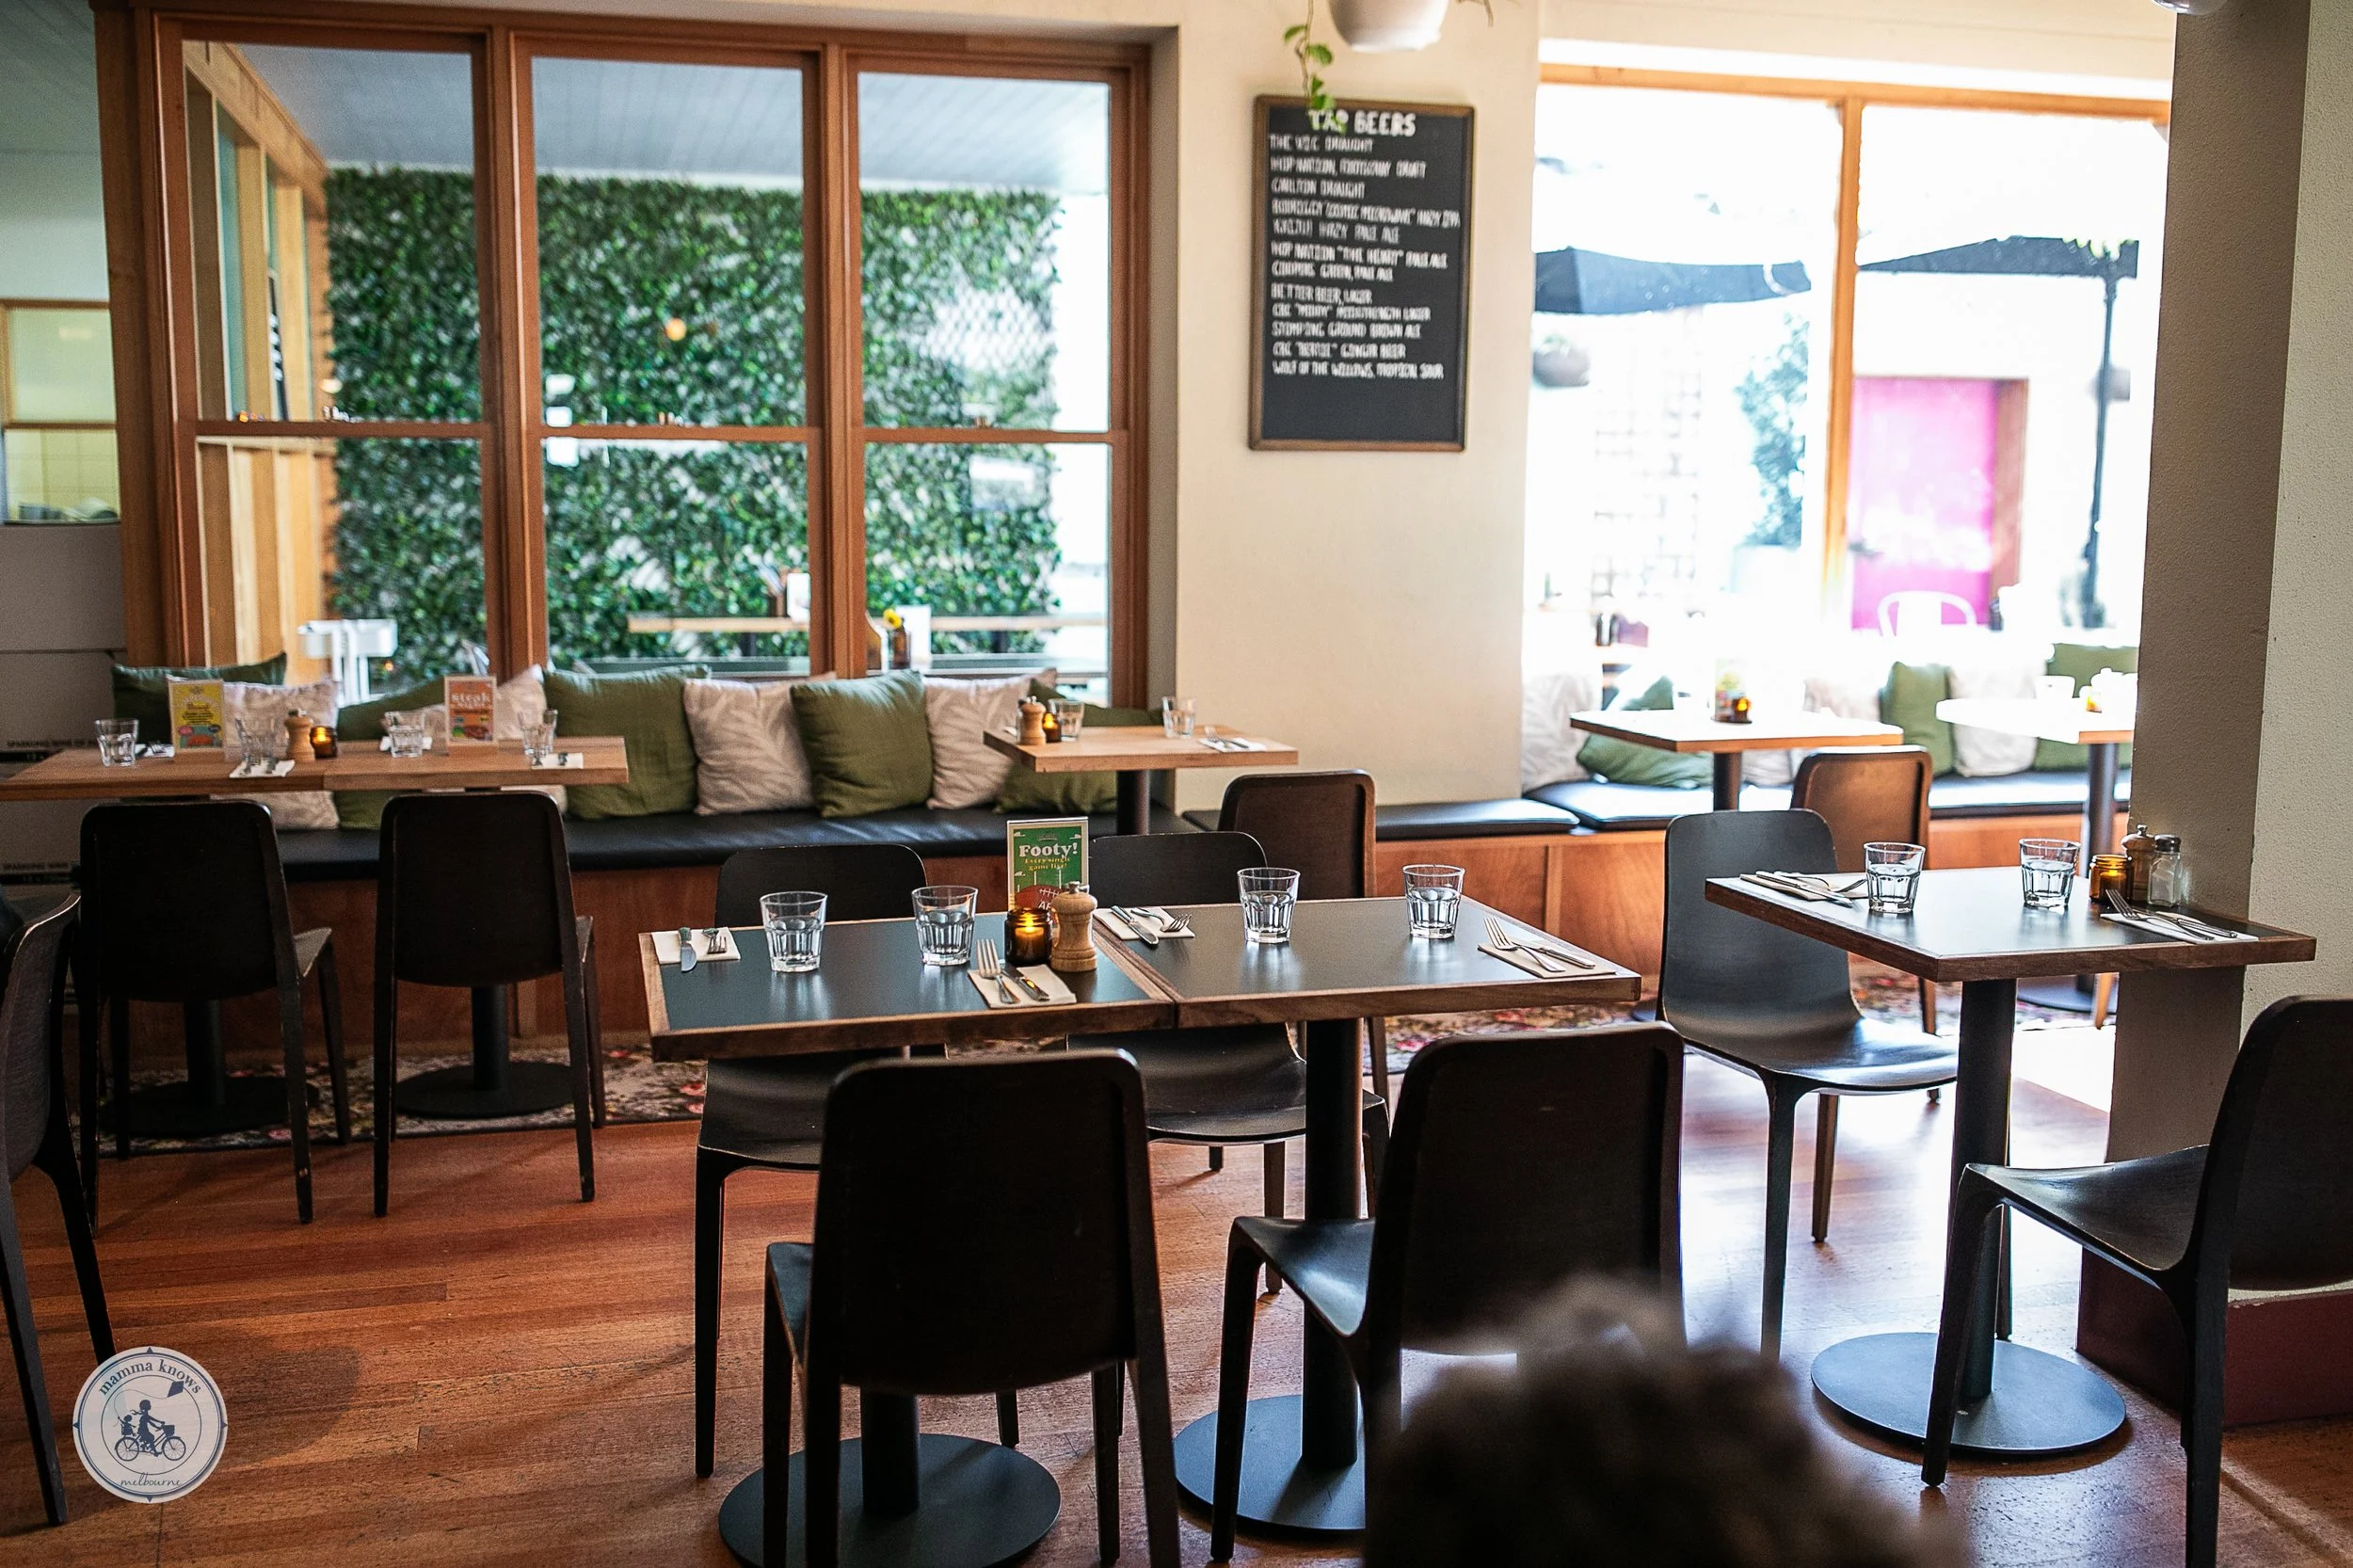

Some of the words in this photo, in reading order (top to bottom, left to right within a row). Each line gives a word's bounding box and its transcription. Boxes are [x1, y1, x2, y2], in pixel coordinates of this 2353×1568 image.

[1307, 108, 1350, 133] TAP
[1353, 109, 1417, 136] BEERS
[1270, 134, 1292, 152] THE
[1271, 155, 1295, 171] HOP
[1272, 177, 1317, 194] CARLTON
[1320, 180, 1365, 199] DRAUGHT
[1319, 221, 1348, 240] HAZY
[1354, 223, 1378, 242] PALE
[1381, 226, 1401, 244] ALE
[1271, 240, 1293, 257] HOP
[1293, 242, 1336, 262] NATION
[1405, 249, 1429, 268] PALE
[1429, 251, 1448, 269] ALE
[1353, 264, 1375, 281] PALE
[1376, 266, 1393, 282] ALE
[1271, 282, 1314, 301] BETTER
[1343, 289, 1372, 305] LAGER
[1402, 306, 1432, 322] LAGER
[1272, 320, 1325, 337] STOMPING
[1327, 322, 1367, 338] GROUND
[1369, 323, 1403, 339] BROWN
[1404, 323, 1422, 340] ALE
[1339, 343, 1378, 360] GINGER
[1379, 343, 1406, 360] BEER
[1272, 360, 1297, 376] WOLF
[1298, 360, 1310, 376] OF
[1311, 361, 1329, 376] THE
[1376, 362, 1417, 378] TROPICAL
[1419, 362, 1444, 379] SOUR
[1018, 841, 1078, 859] Footy!
